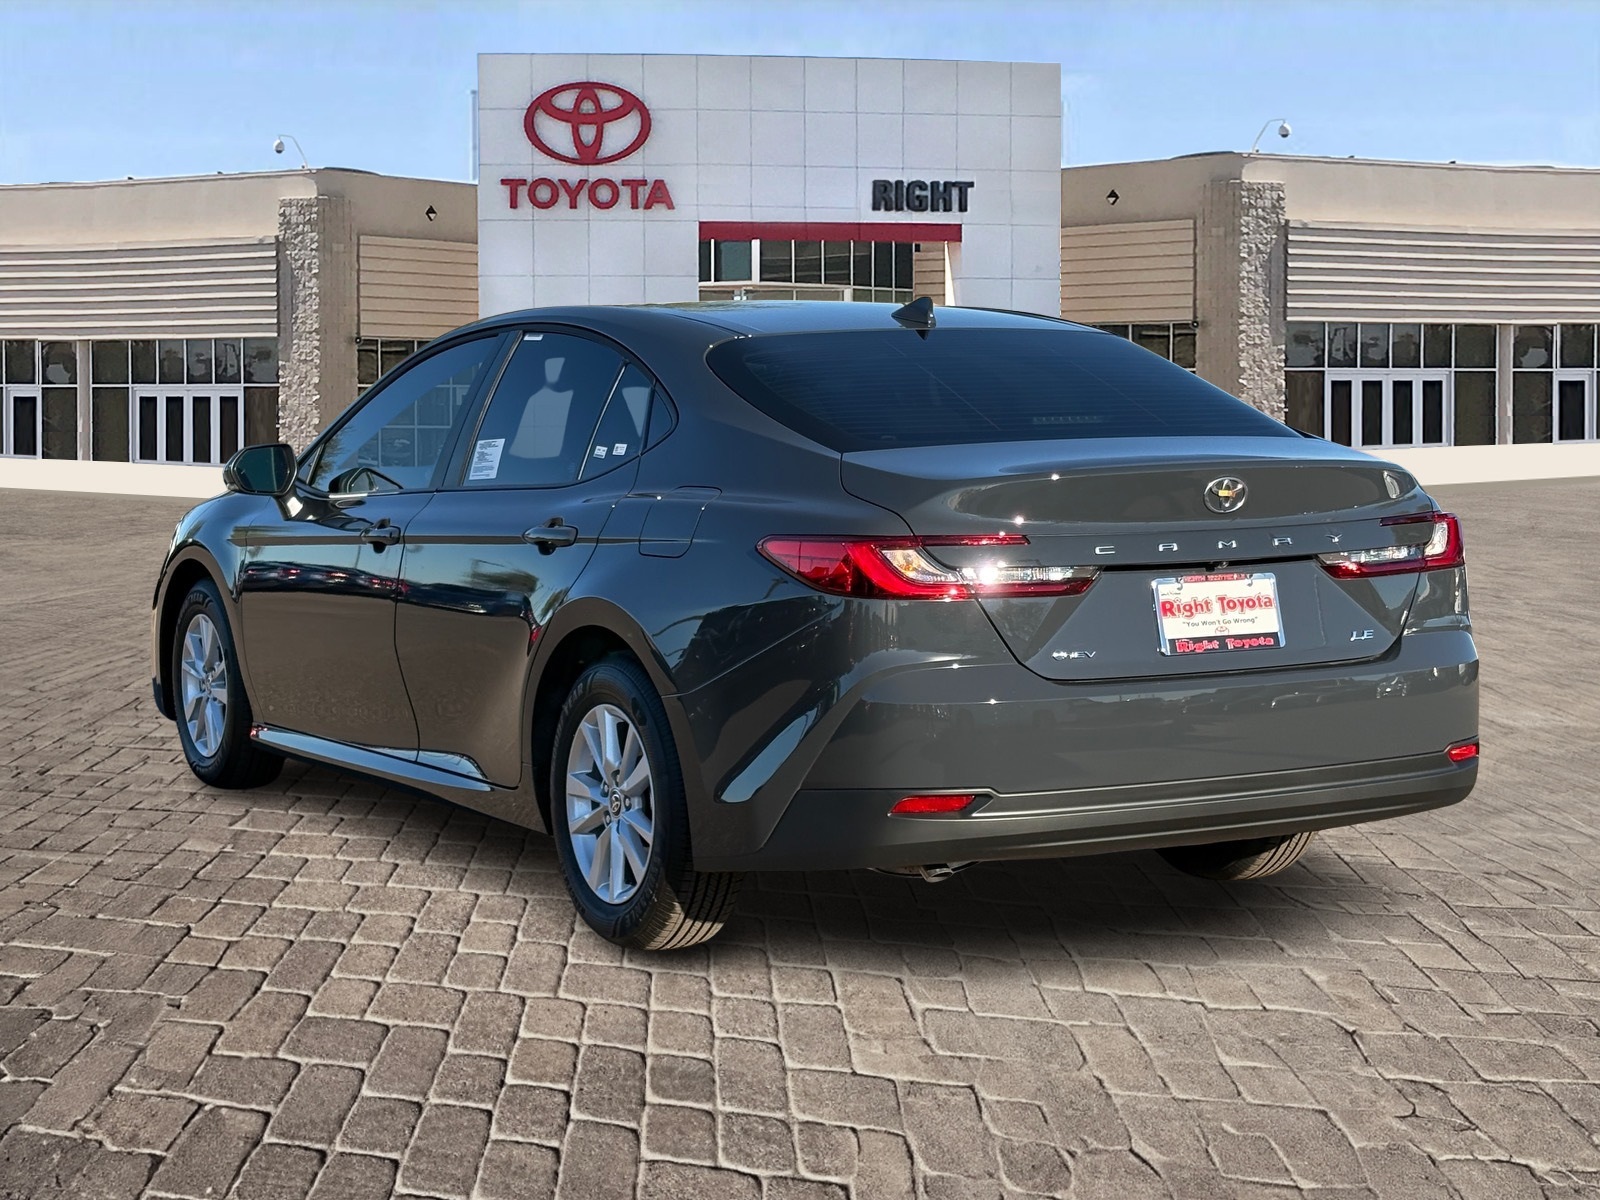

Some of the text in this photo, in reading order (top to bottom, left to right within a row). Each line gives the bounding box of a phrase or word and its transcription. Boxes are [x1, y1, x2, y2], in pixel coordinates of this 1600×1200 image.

[500, 178, 676, 210] TOYOTA
[871, 179, 975, 213] RIGHT
[1094, 534, 1343, 556] CAMRY
[1160, 592, 1274, 619] Right Toyota
[1233, 616, 1258, 624] Wrong"
[1175, 635, 1274, 653] Right Toyota
[1350, 629, 1374, 641] LE
